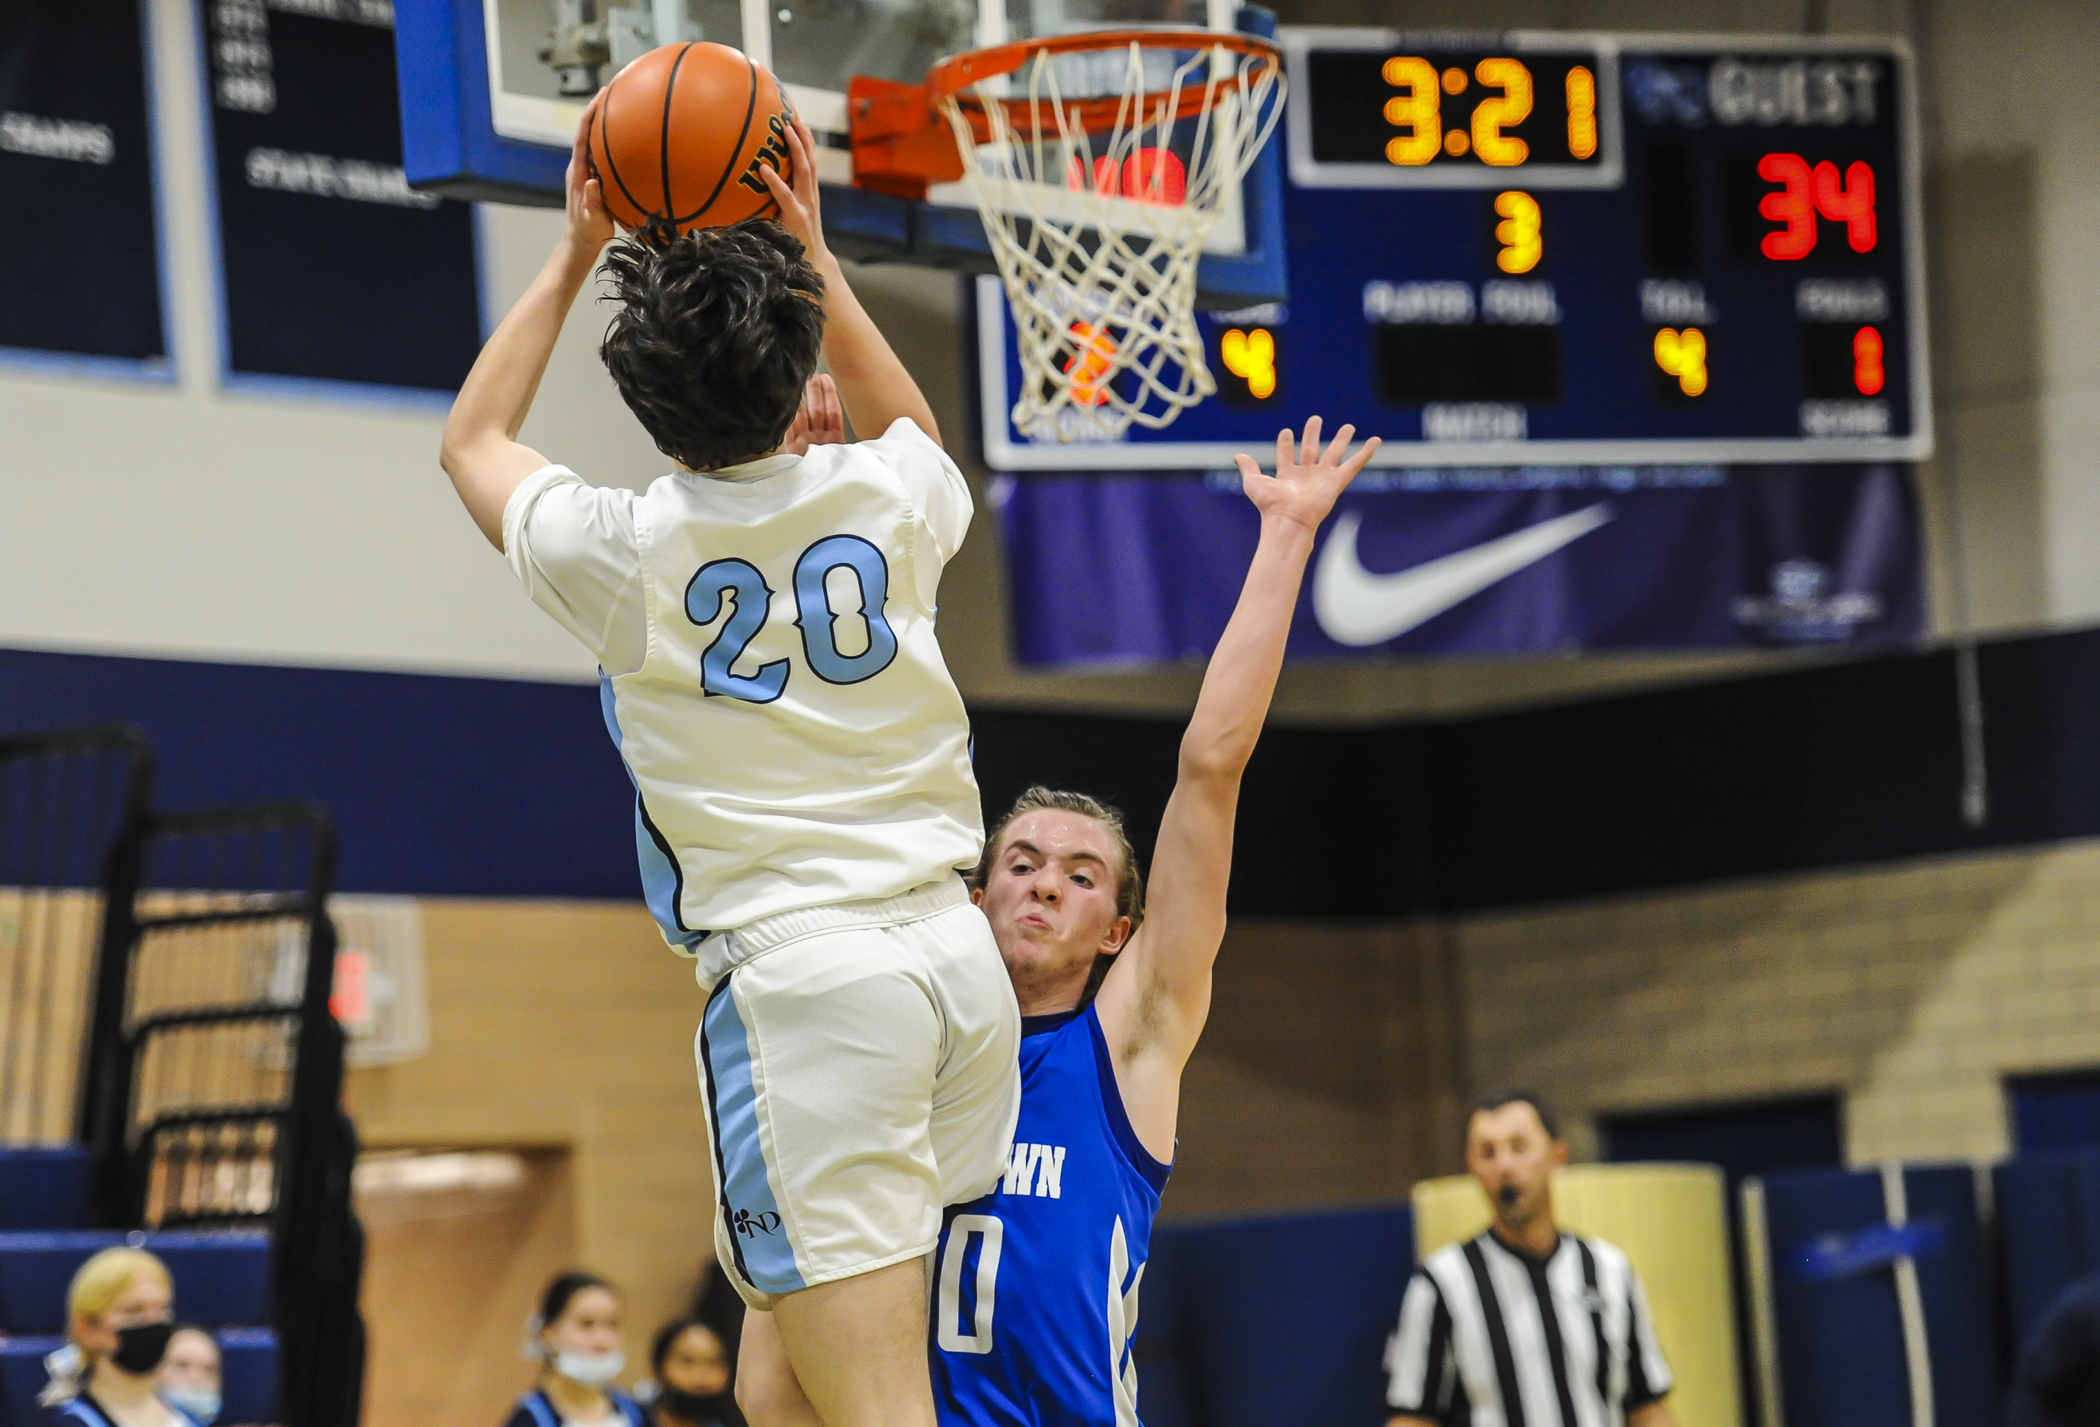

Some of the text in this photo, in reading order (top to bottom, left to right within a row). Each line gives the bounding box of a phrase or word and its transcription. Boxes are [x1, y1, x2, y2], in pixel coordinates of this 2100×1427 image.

[736, 72, 794, 195] Wil
[1381, 56, 1598, 166] 3:21
[1494, 190, 1543, 274] 3
[1758, 153, 1877, 260] 34
[1221, 328, 1276, 399] 4
[1654, 327, 1708, 397] 4
[1853, 326, 1885, 396] 1
[684, 533, 899, 705] 20
[986, 1142, 1067, 1199] WN
[743, 1211, 782, 1240] ND
[937, 1213, 1004, 1355] 0
